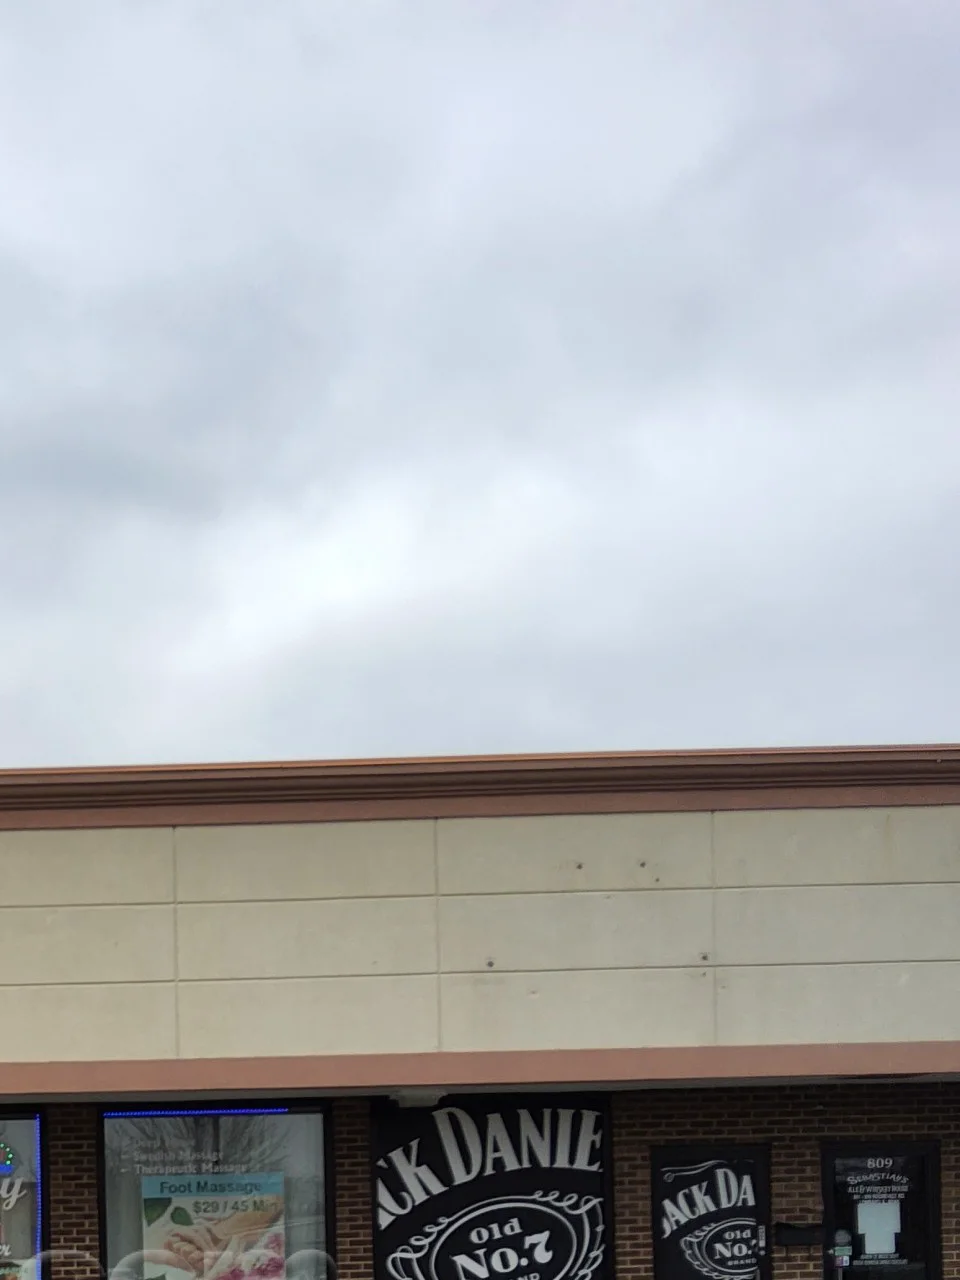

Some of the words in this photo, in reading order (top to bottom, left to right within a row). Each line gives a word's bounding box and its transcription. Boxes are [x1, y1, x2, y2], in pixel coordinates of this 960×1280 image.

[136, 1163, 197, 1175] Therapeutic
[867, 1157, 893, 1169] 809
[160, 1181, 193, 1194] Foot
[196, 1180, 262, 1196] Massage
[376, 1138, 449, 1231] CK
[192, 1200, 219, 1213] $29
[231, 1199, 249, 1212] 45
[660, 1181, 718, 1239] JACK
[469, 1217, 522, 1244] Old
[723, 1229, 751, 1240] Old
